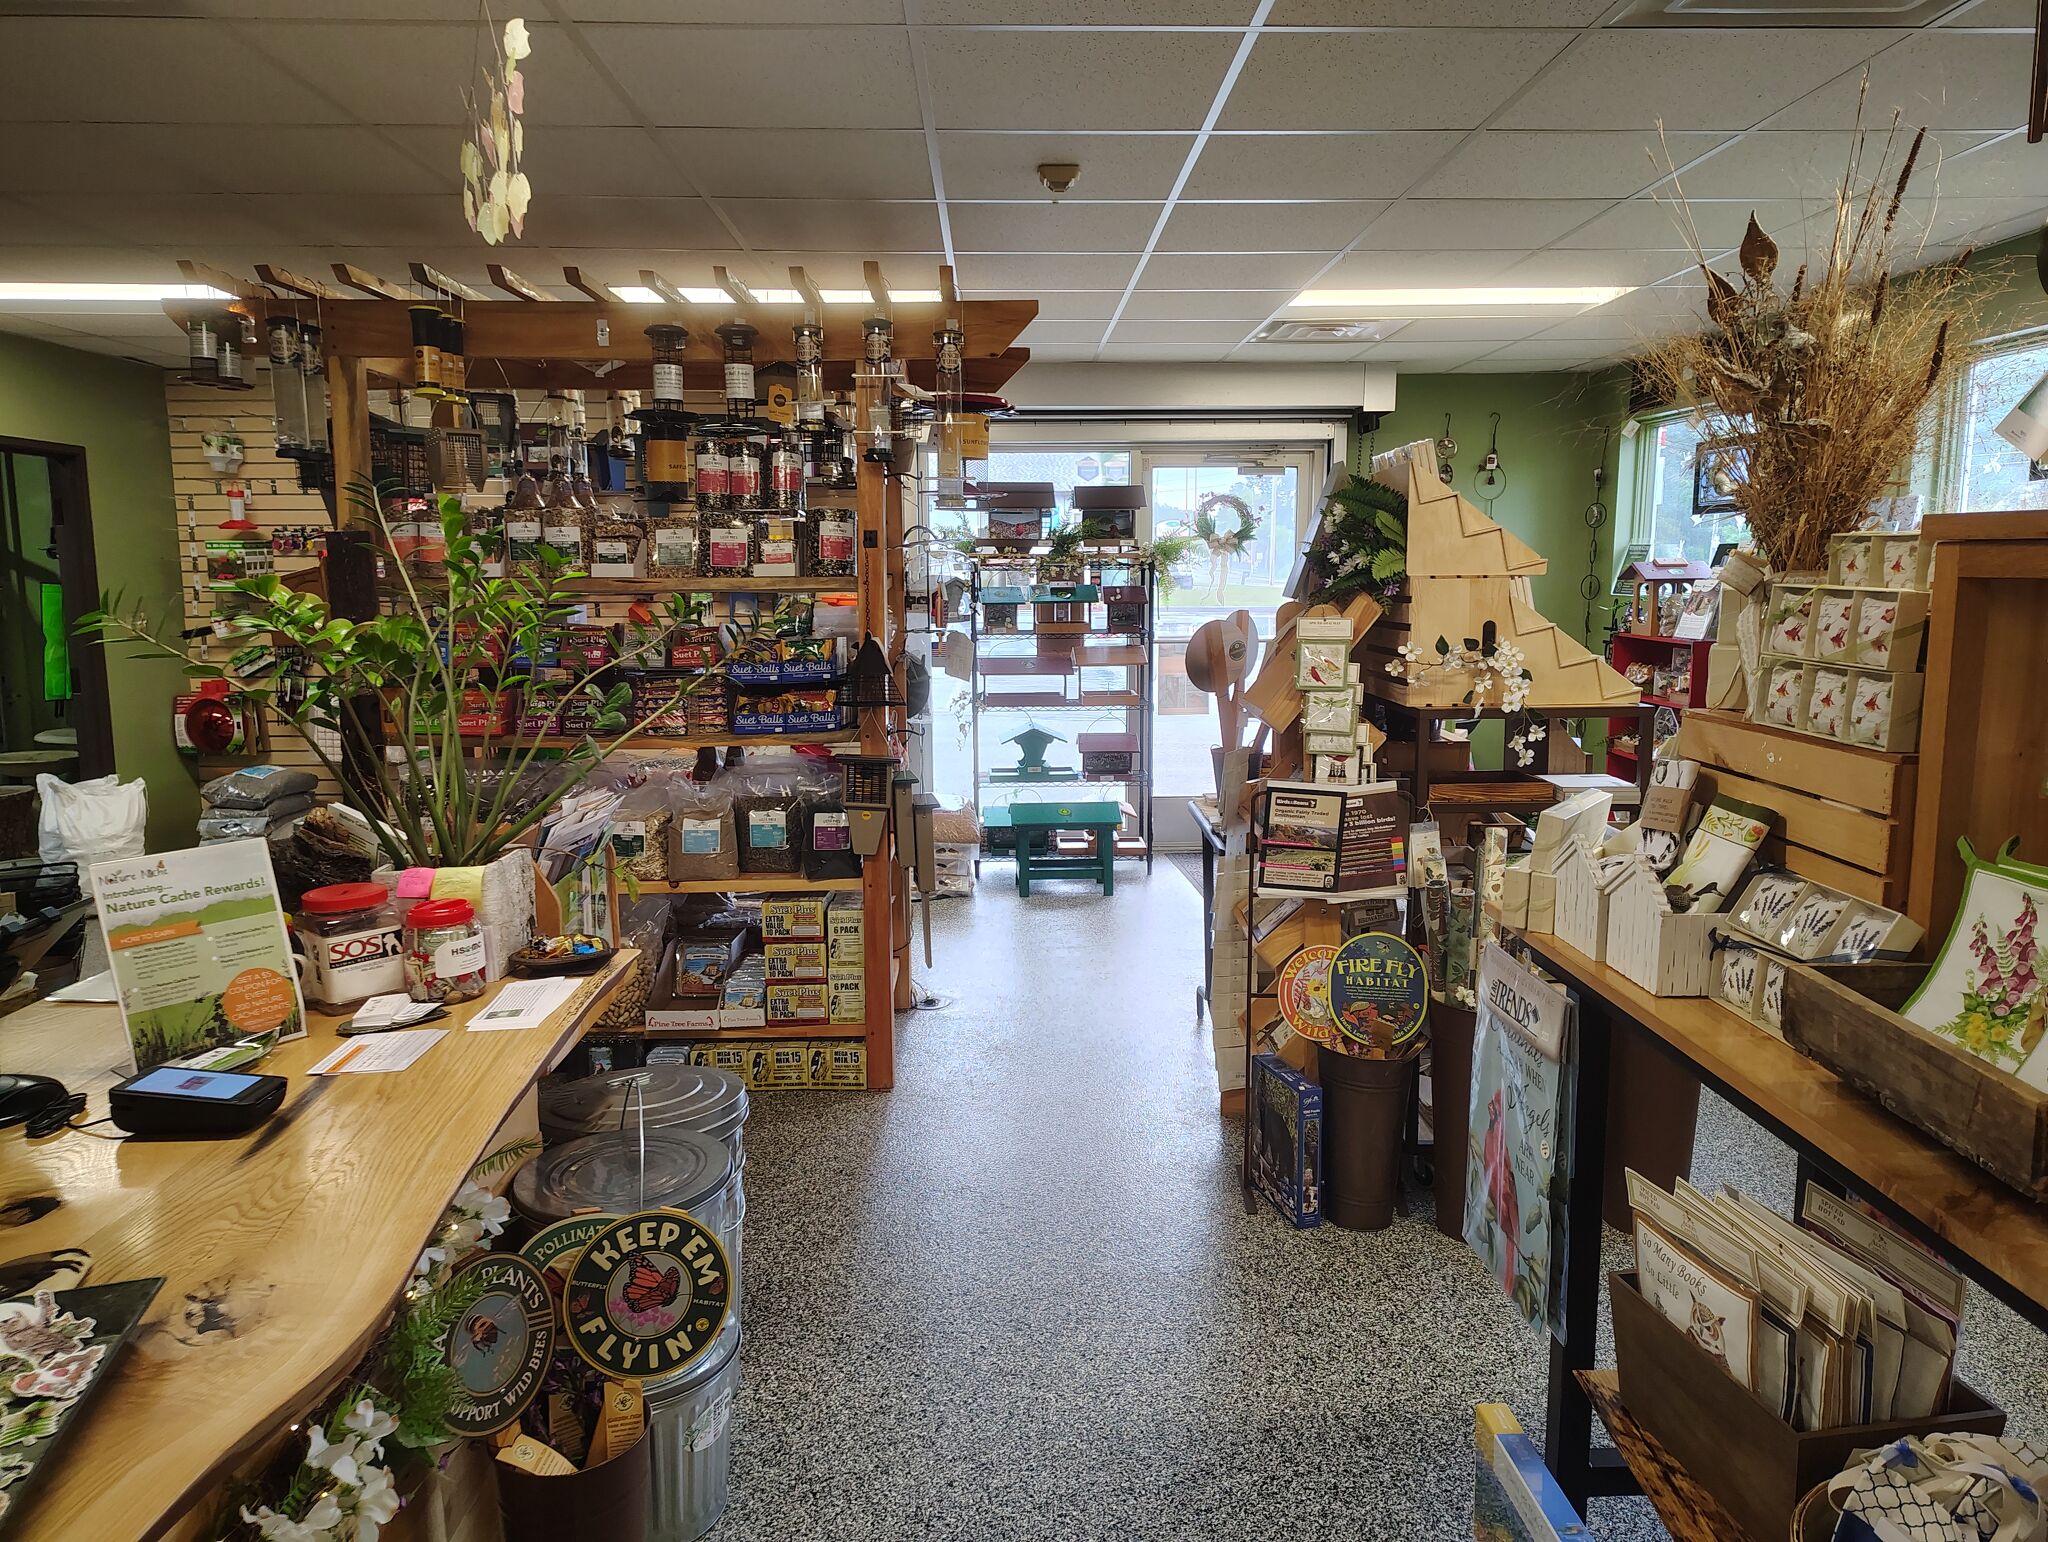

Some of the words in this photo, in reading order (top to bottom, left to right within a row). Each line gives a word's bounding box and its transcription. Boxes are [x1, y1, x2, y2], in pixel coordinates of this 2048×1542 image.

[673, 651, 693, 659] Suet
[731, 665, 752, 674] Suet
[757, 664, 780, 674] Balls
[783, 663, 804, 672] Suet
[806, 662, 832, 671] Balls
[735, 715, 757, 725] Suet
[758, 715, 784, 724] Balls
[788, 714, 809, 723] Suet
[810, 713, 836, 722] Balls
[565, 721, 584, 729] Suet
[1376, 815, 1396, 823] birds!
[99, 869, 136, 887] Nature
[106, 899, 156, 914] Nature
[159, 889, 201, 904] Cache
[204, 877, 266, 896] Rewards!
[770, 905, 792, 914] Suet
[794, 905, 815, 914] Plus
[330, 936, 381, 961] SOS
[773, 947, 795, 956] Suet
[797, 947, 818, 956] Plus
[777, 970, 793, 978] PACK
[834, 983, 839, 991] 6
[840, 982, 859, 990] PACK
[1346, 976, 1409, 988] HABITAT
[776, 988, 797, 997] Suet
[799, 987, 820, 996] Plus
[1497, 979, 1533, 1028] TRENDS
[671, 1020, 685, 1028] Tree
[686, 1020, 709, 1028] Farms
[1292, 1014, 1329, 1038] Wild
[733, 1051, 742, 1064] 15
[776, 1056, 790, 1064] MIX
[791, 1051, 801, 1063] 15
[849, 1051, 860, 1063] 15
[1515, 1153, 1535, 1187] NEAR
[1820, 1198, 1844, 1218] SPICED
[1818, 1204, 1832, 1217] HOT
[1832, 1213, 1846, 1226] PAD
[534, 1225, 606, 1262] POLLINAT
[590, 1221, 680, 1272] KEEP
[1641, 1232, 1651, 1247] So
[1653, 1241, 1676, 1273] Many
[1677, 1264, 1707, 1297] Books
[1645, 1261, 1655, 1276] So
[1657, 1271, 1680, 1300] Little
[481, 1265, 545, 1309] PLANTS
[693, 1298, 726, 1308] HABITAT
[451, 1401, 500, 1422] UPPORT
[503, 1371, 533, 1407] WILD
[528, 1330, 548, 1371] BEES
